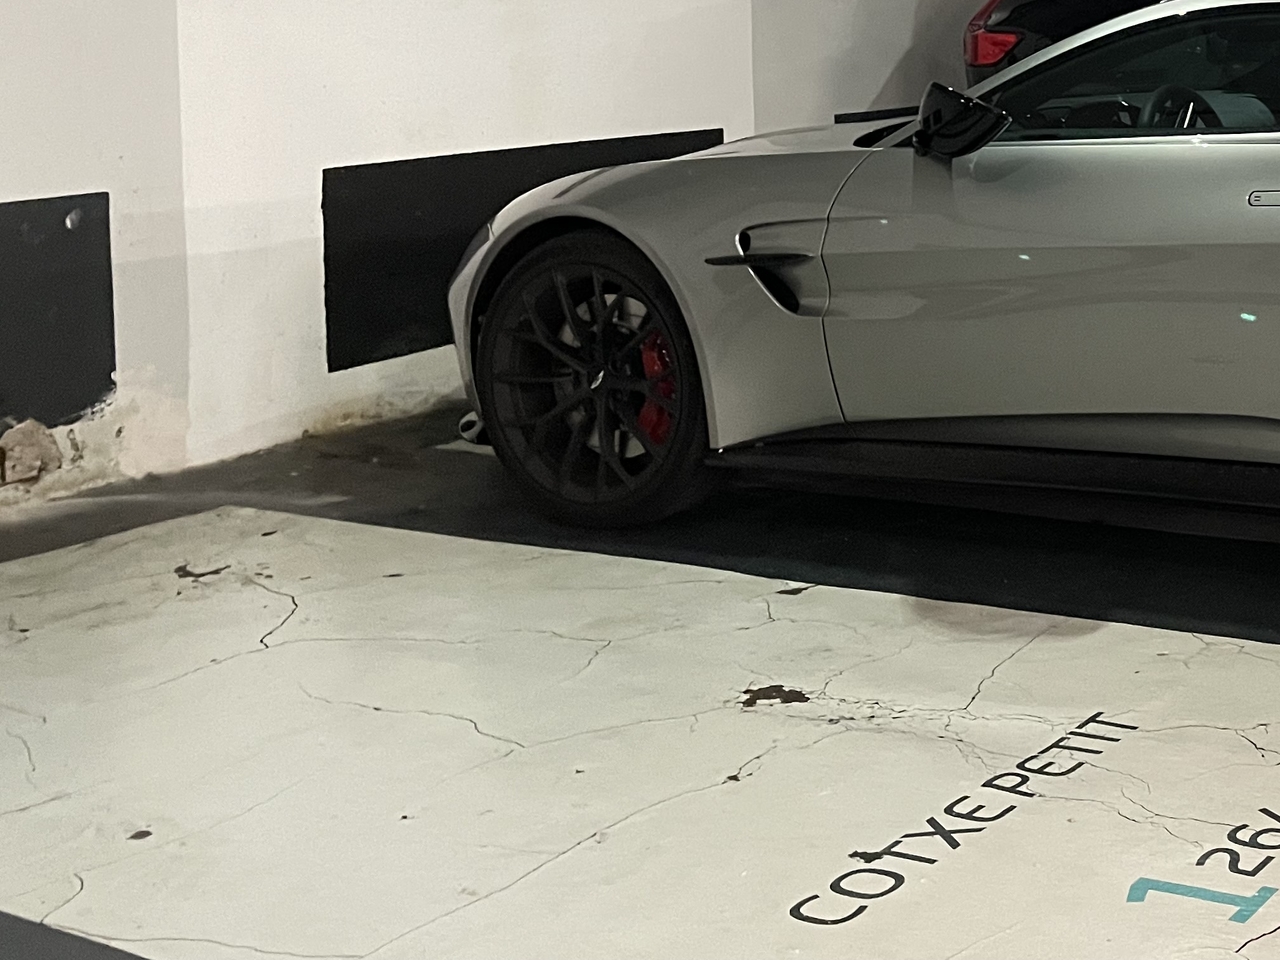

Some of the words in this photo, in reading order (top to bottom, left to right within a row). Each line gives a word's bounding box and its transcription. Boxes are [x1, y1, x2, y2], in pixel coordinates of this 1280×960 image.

[788, 794, 1018, 926] COTXE
[980, 711, 1140, 798] PETIT
[1126, 876, 1280, 924] 1
